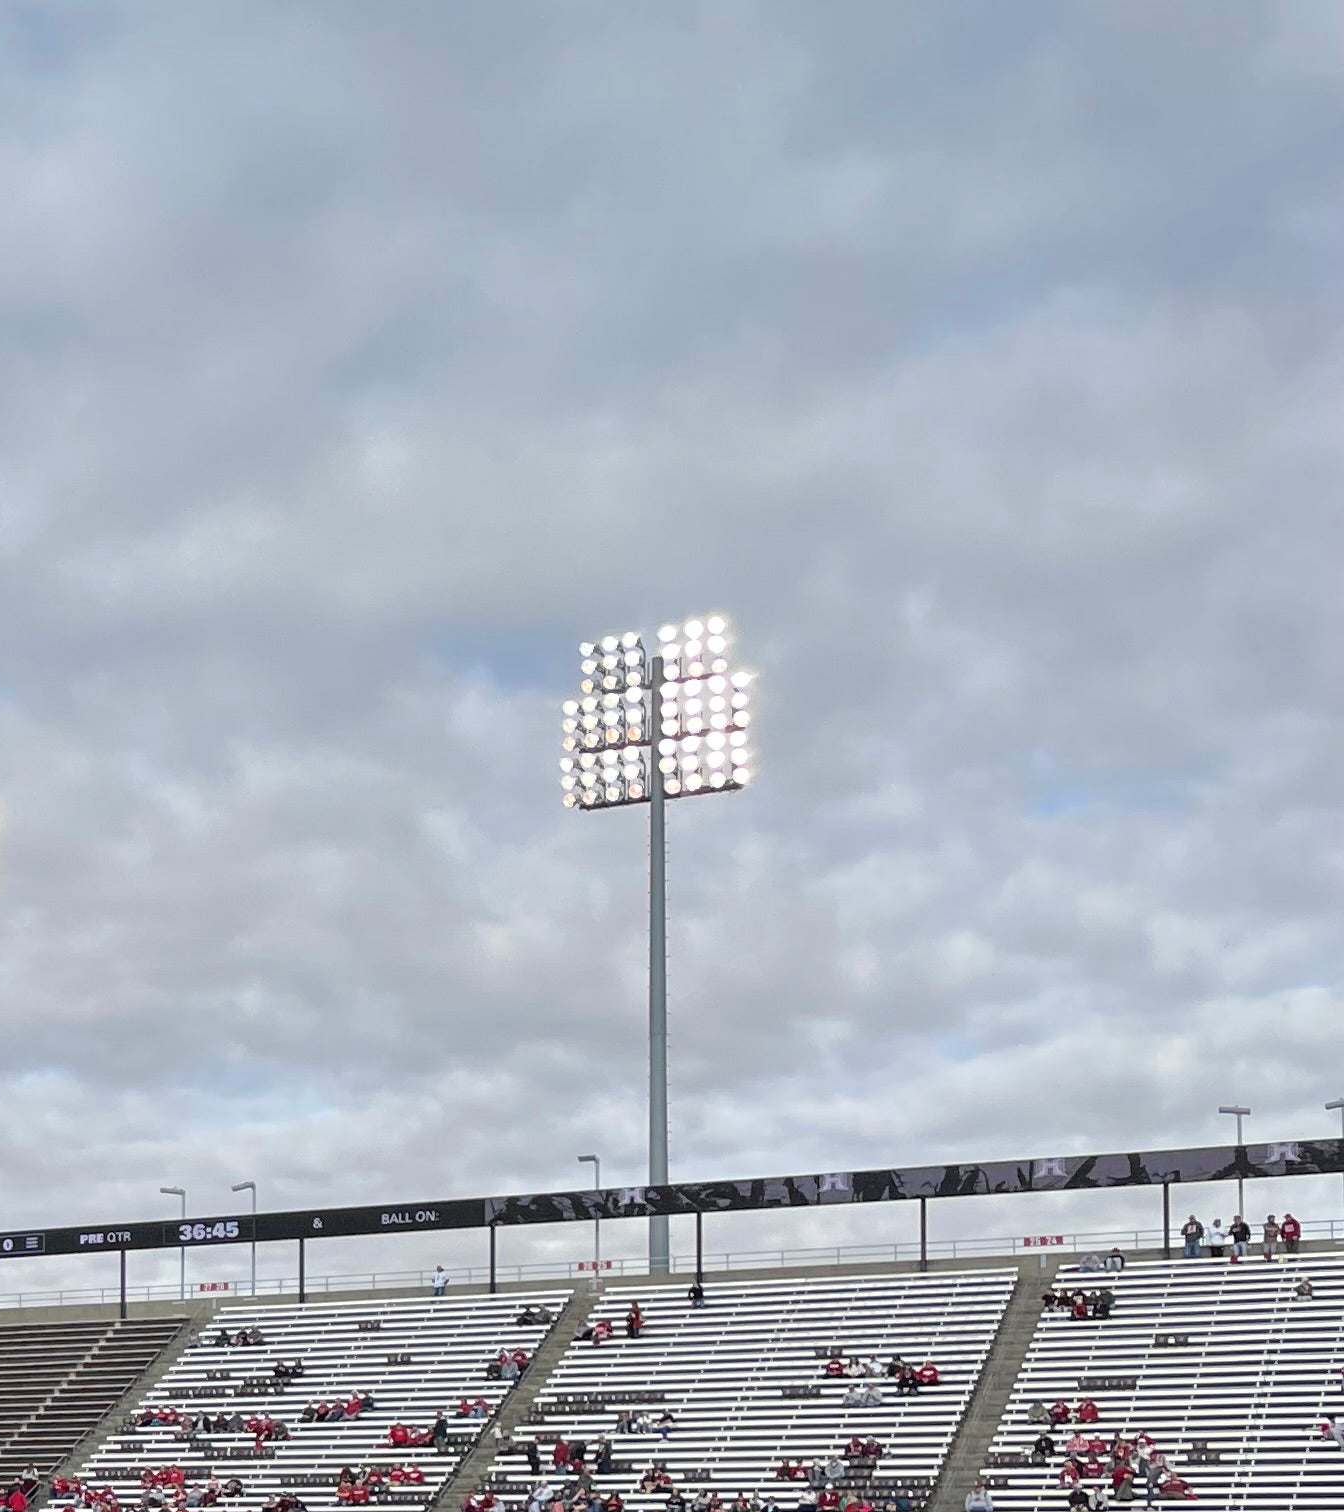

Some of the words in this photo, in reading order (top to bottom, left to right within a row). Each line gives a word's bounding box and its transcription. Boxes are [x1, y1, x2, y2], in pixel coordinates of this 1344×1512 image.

[312, 1217, 323, 1229] &
[381, 1212, 412, 1226] BALL
[80, 1233, 104, 1245] PRE
[107, 1231, 132, 1243] QTR
[179, 1221, 239, 1242] 36:45
[3, 1238, 13, 1251] 0
